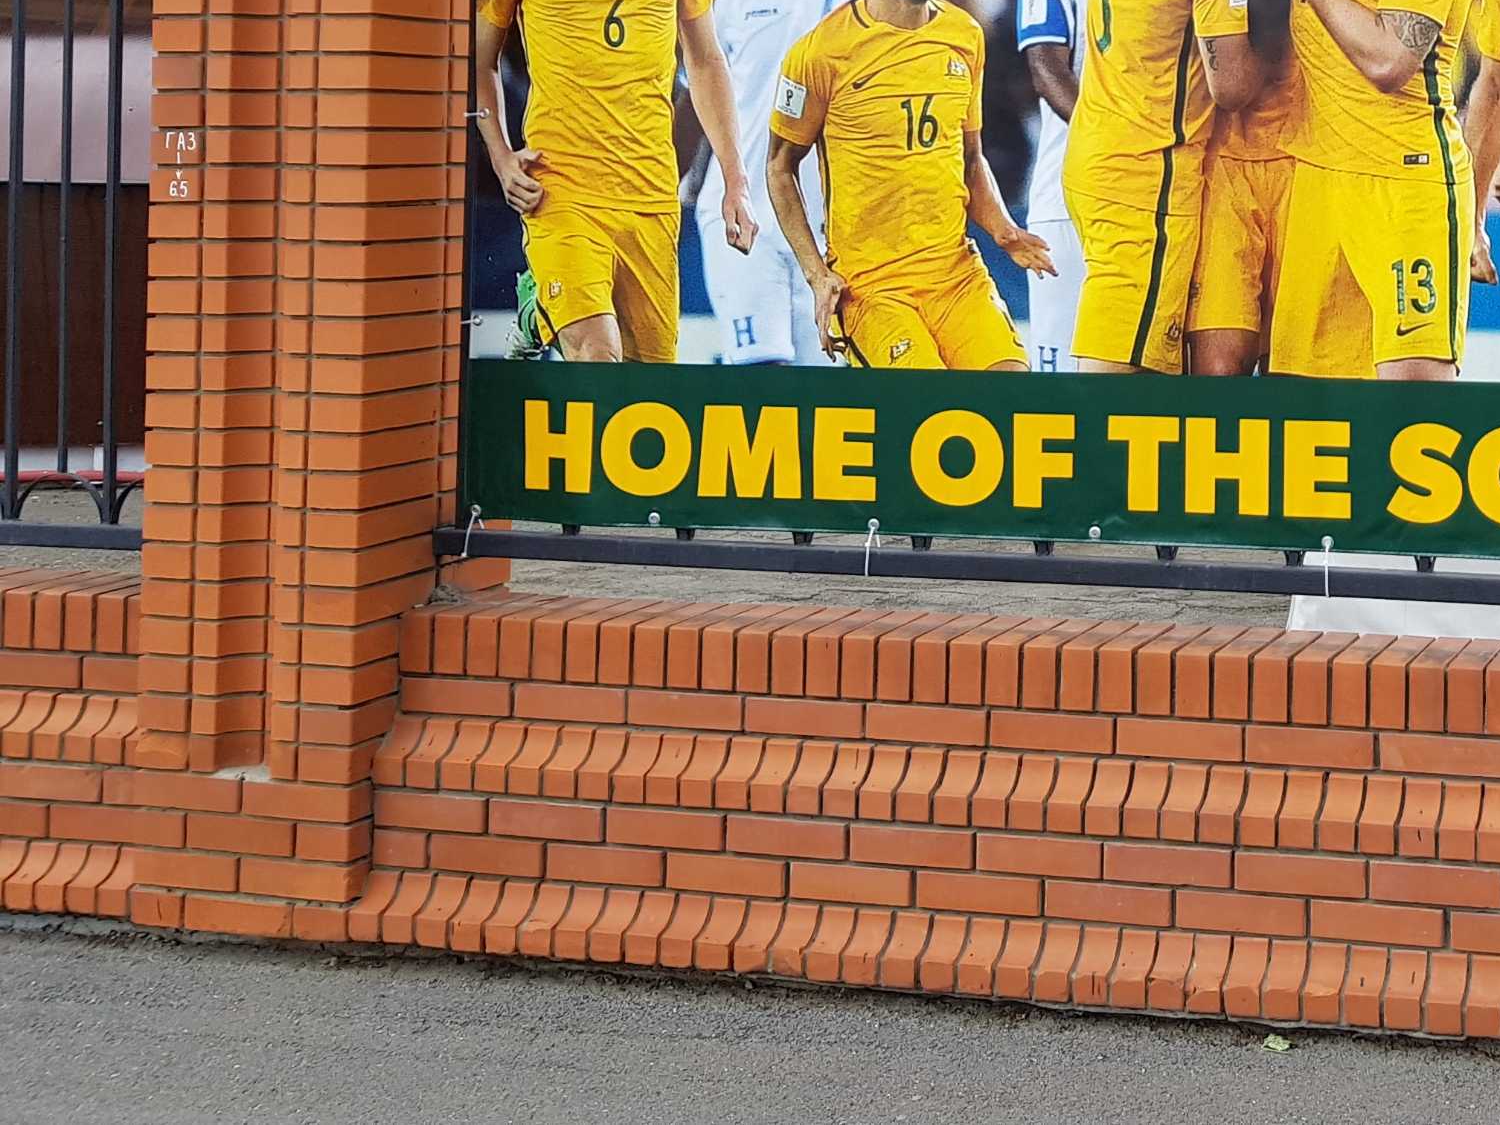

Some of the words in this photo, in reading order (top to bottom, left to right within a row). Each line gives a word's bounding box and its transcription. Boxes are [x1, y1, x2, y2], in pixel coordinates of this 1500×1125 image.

[604, 0, 625, 47] 6
[165, 131, 197, 151] ГАЗ
[901, 94, 938, 151] 16
[1391, 258, 1436, 315] 13
[733, 316, 756, 347] H
[1038, 345, 1058, 372] H
[524, 400, 877, 501] HOME
[910, 410, 1075, 508] OF
[1107, 415, 1352, 519] THE
